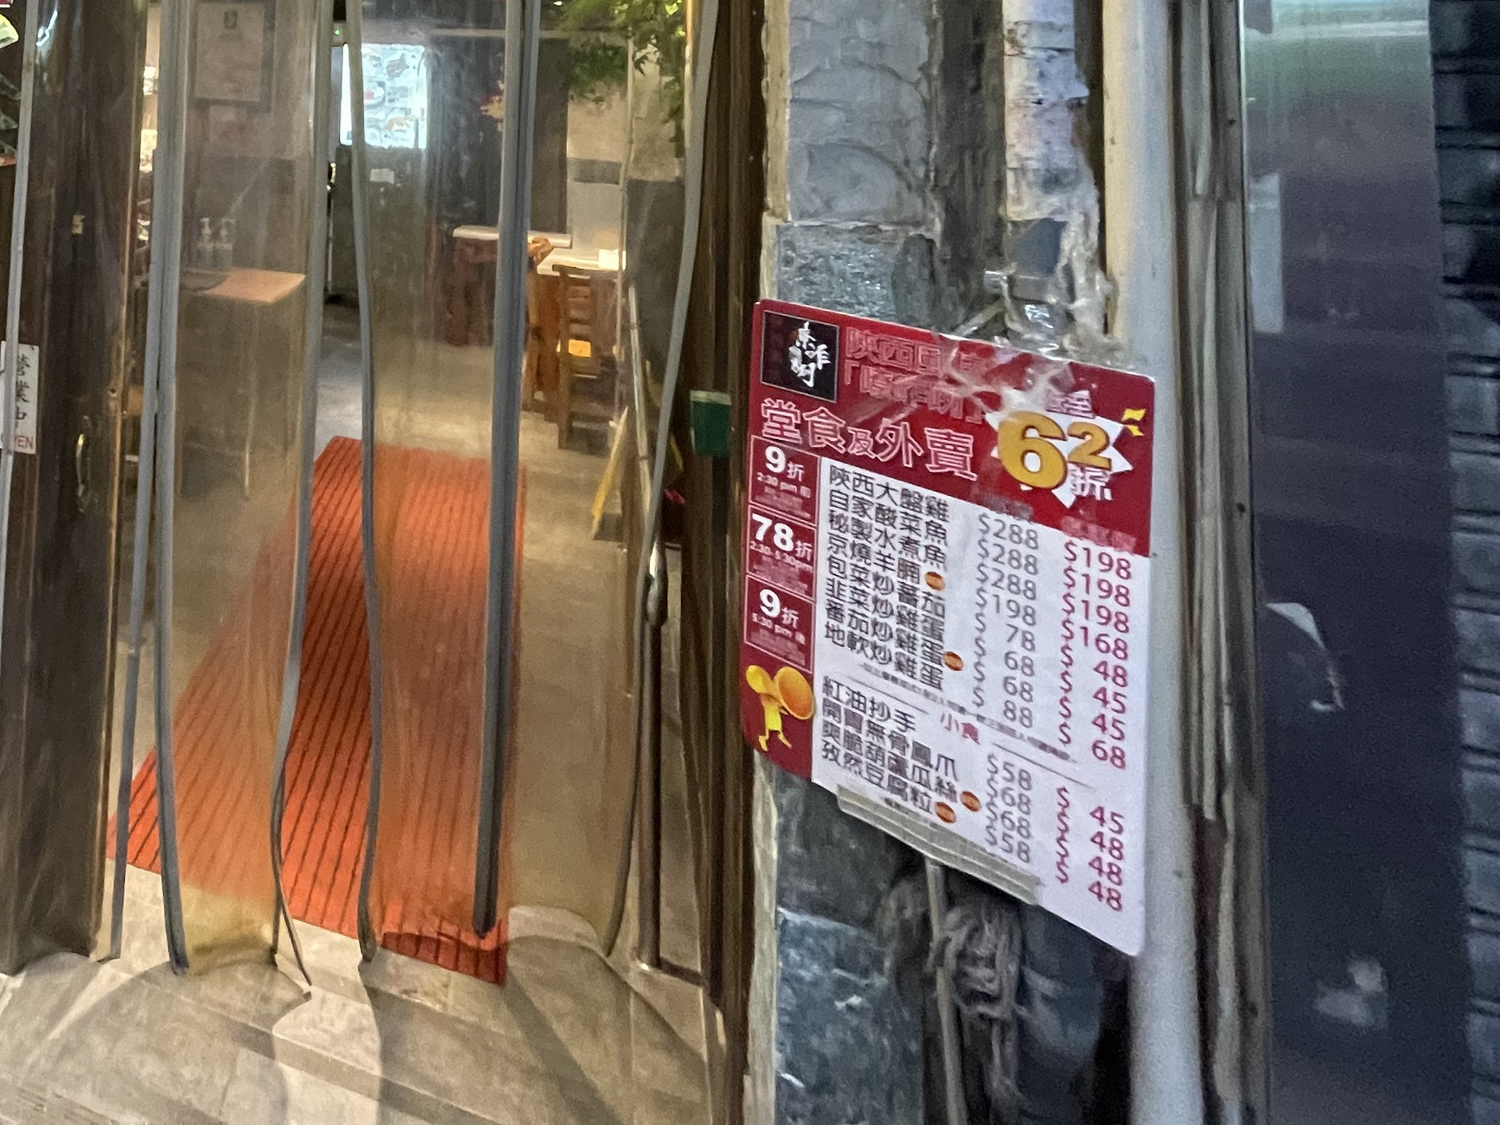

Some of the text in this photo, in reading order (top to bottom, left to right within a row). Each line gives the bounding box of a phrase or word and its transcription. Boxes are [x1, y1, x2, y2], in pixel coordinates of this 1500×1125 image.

[760, 396, 978, 482] 堂食及外賣
[764, 446, 805, 482] 9折
[751, 513, 813, 562] 78折
[829, 489, 948, 547] 自家酸菜魚
[977, 537, 1039, 576] $288
[1063, 565, 1131, 608] $198
[978, 512, 1039, 551] $288
[1064, 539, 1132, 581] $198
[759, 588, 800, 628] 9折
[975, 586, 1037, 627] $198
[1061, 618, 1130, 661] $168
[976, 562, 1037, 601] $288
[1062, 591, 1130, 634] $198
[822, 675, 917, 734] 紅油抄手
